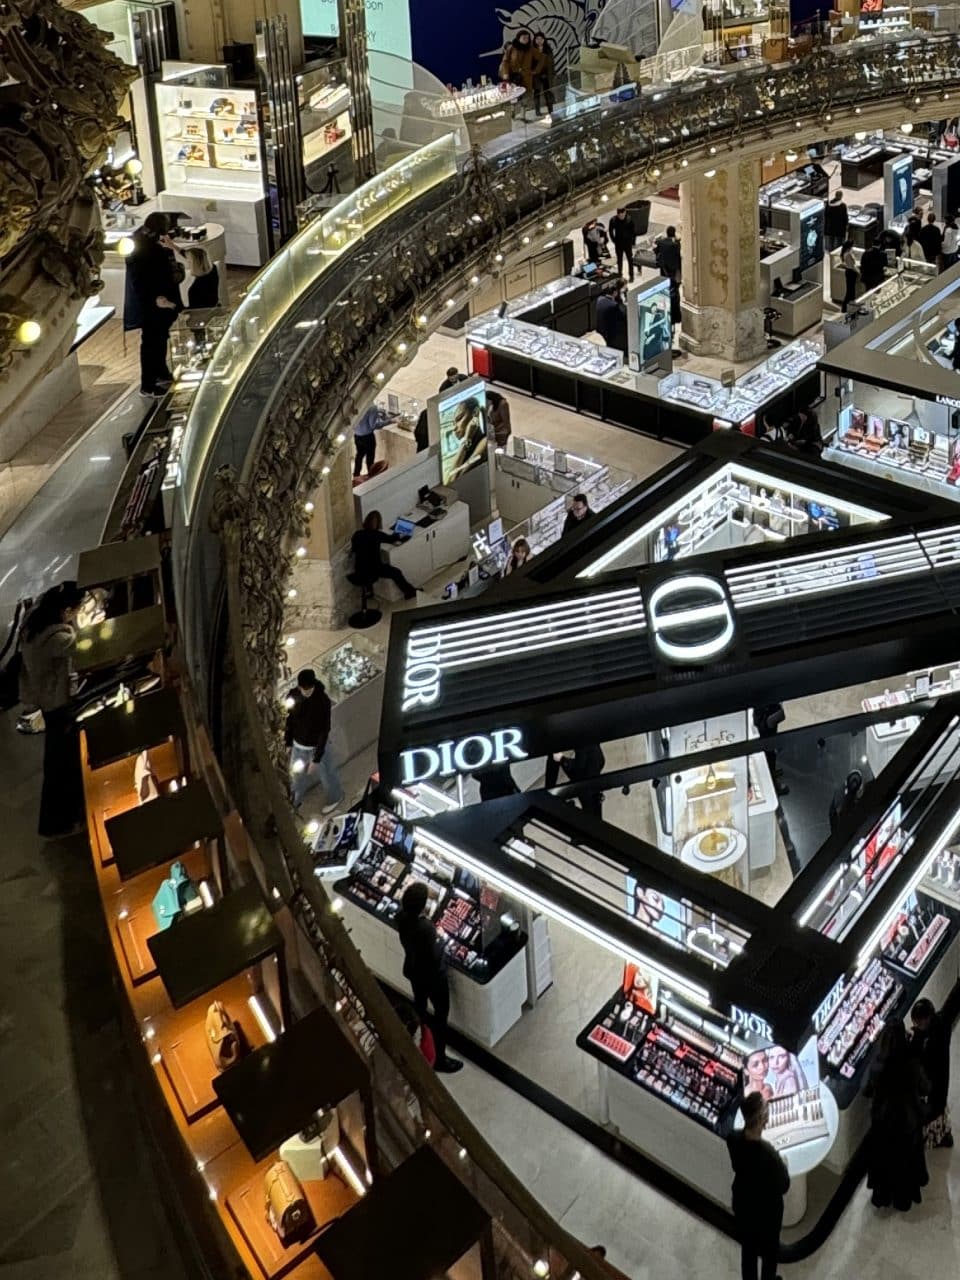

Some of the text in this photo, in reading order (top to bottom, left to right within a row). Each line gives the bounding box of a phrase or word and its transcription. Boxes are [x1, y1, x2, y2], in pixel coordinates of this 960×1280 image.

[401, 634, 441, 712] DIOR
[400, 727, 528, 785] DIOR
[731, 1004, 774, 1042] DIOR
[812, 972, 846, 1032] DIOR
